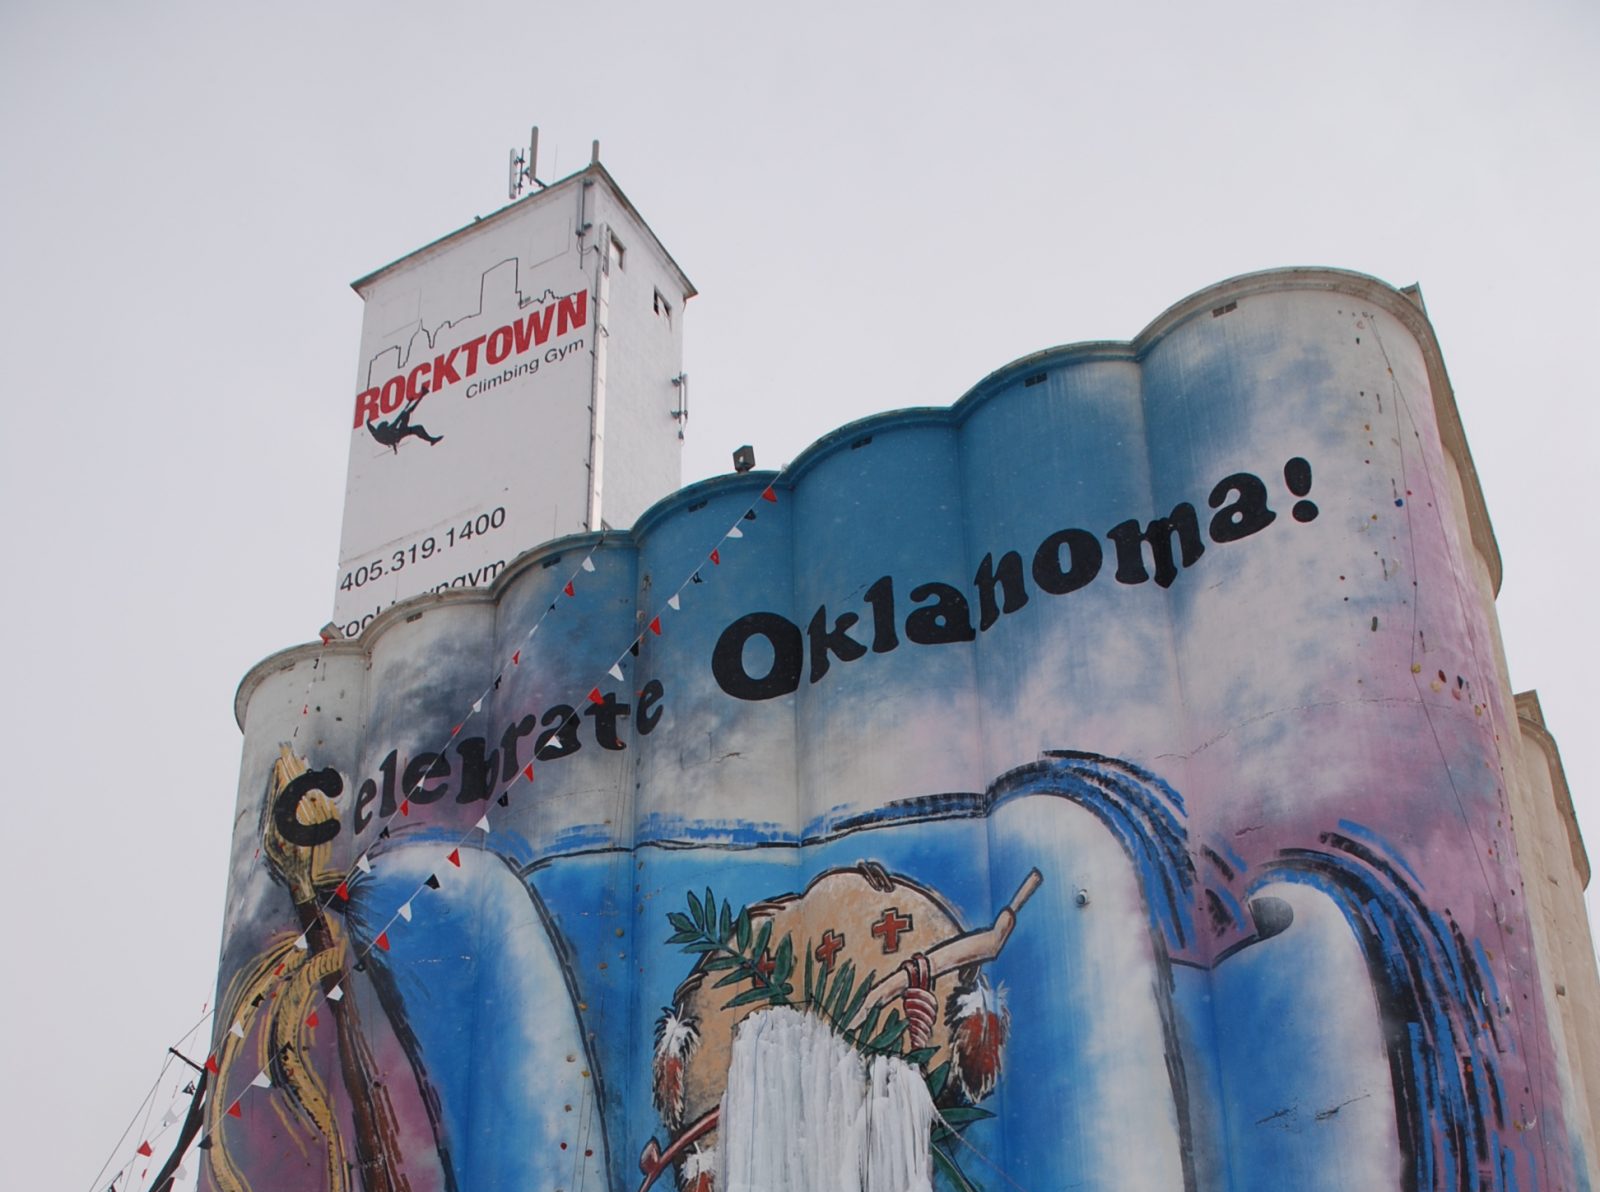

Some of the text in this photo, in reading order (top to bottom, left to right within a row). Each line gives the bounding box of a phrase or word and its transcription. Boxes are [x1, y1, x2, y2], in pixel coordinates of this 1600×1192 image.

[353, 289, 588, 429] ROCKTOWN
[466, 338, 584, 398] Climbing Gym
[340, 506, 506, 591] 405.319.1400
[275, 679, 664, 847] Celebrate
